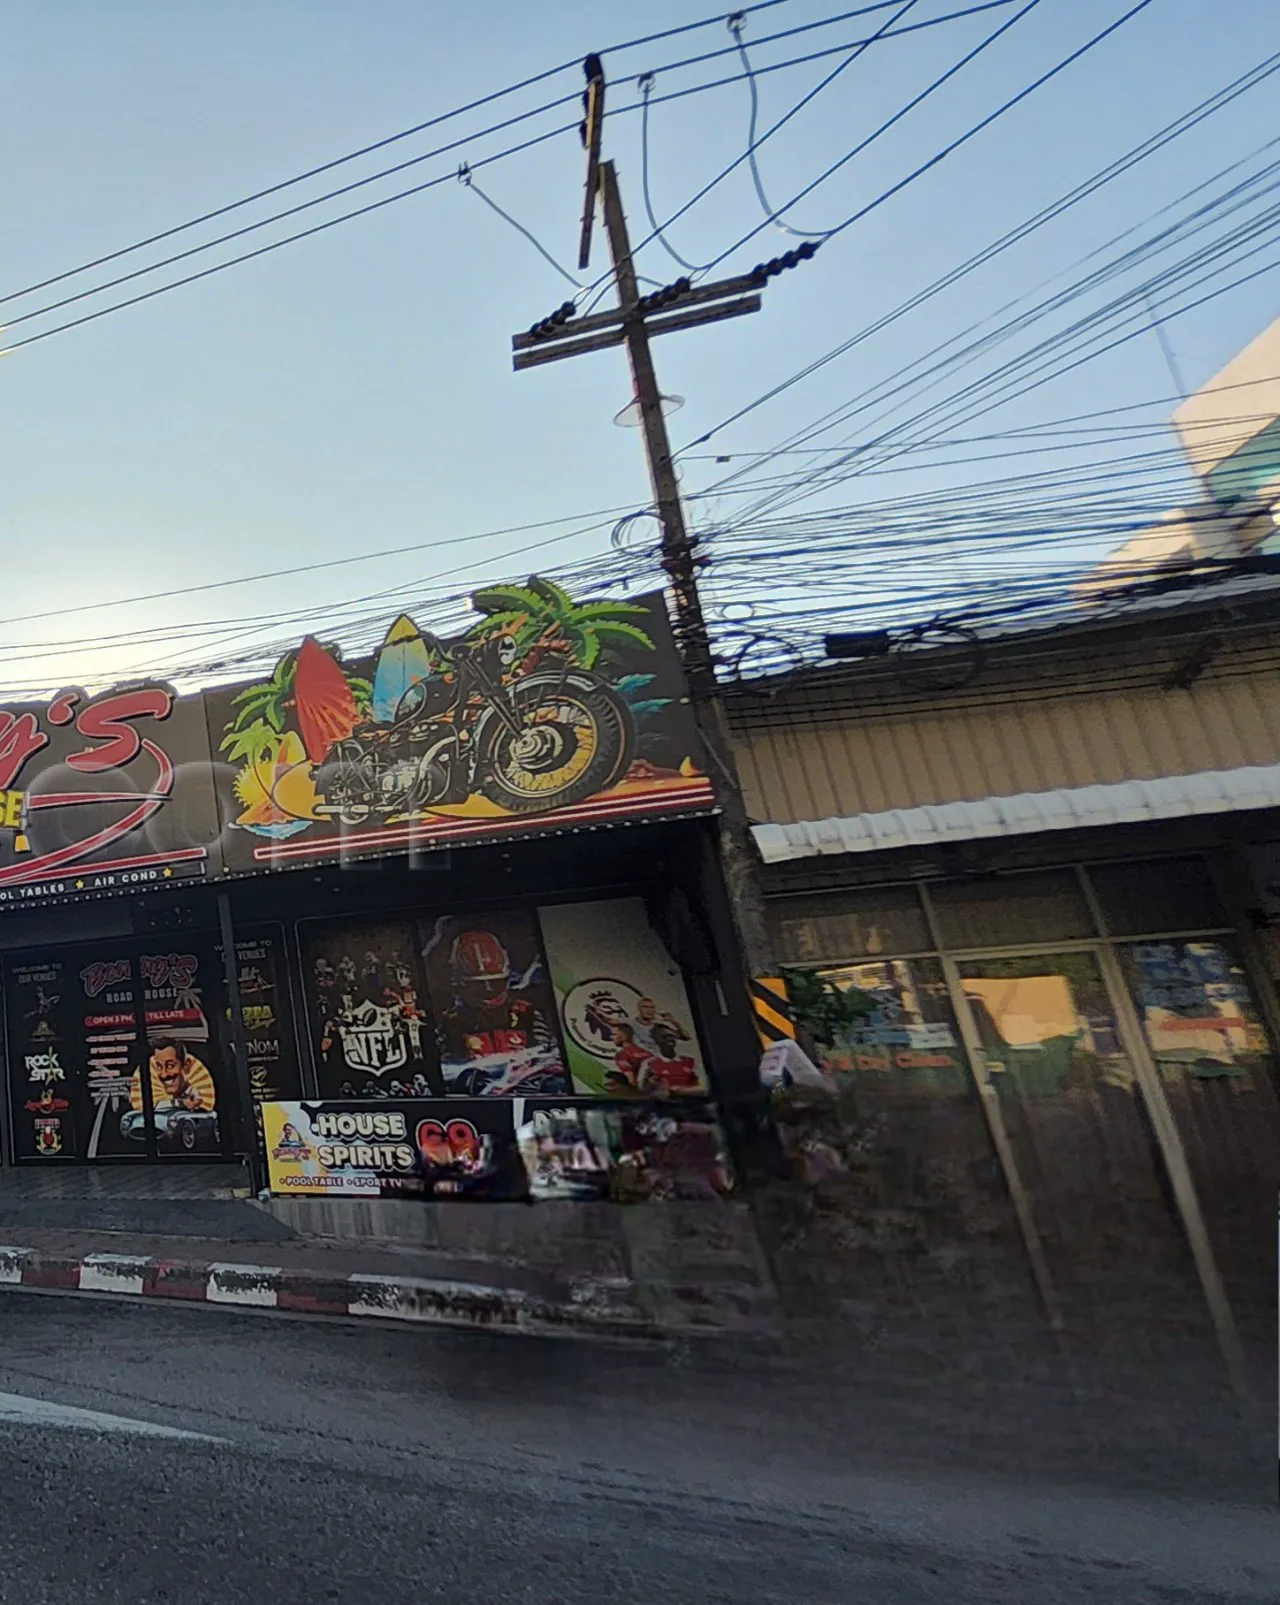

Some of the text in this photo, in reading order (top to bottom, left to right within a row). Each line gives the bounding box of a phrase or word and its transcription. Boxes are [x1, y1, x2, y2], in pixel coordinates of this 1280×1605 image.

[94, 868, 158, 887] AIR COND
[20, 881, 65, 898] TABLES
[237, 948, 267, 961] VENUES
[106, 988, 178, 1003] ROAD HOUSE
[92, 1016, 114, 1025] OPEN
[120, 1014, 134, 1023] PM
[147, 1011, 164, 1019] TILL
[165, 1010, 185, 1019] LATE
[347, 1033, 401, 1068] NFL
[24, 1053, 60, 1070] ROCK
[28, 1067, 66, 1082] STAR
[318, 1114, 405, 1137] HOUSE
[416, 1119, 480, 1168] 69
[319, 1145, 413, 1169] SPIRITS
[286, 1175, 311, 1187] POOL
[312, 1175, 343, 1187] TABLE
[354, 1177, 387, 1187] SPORT
